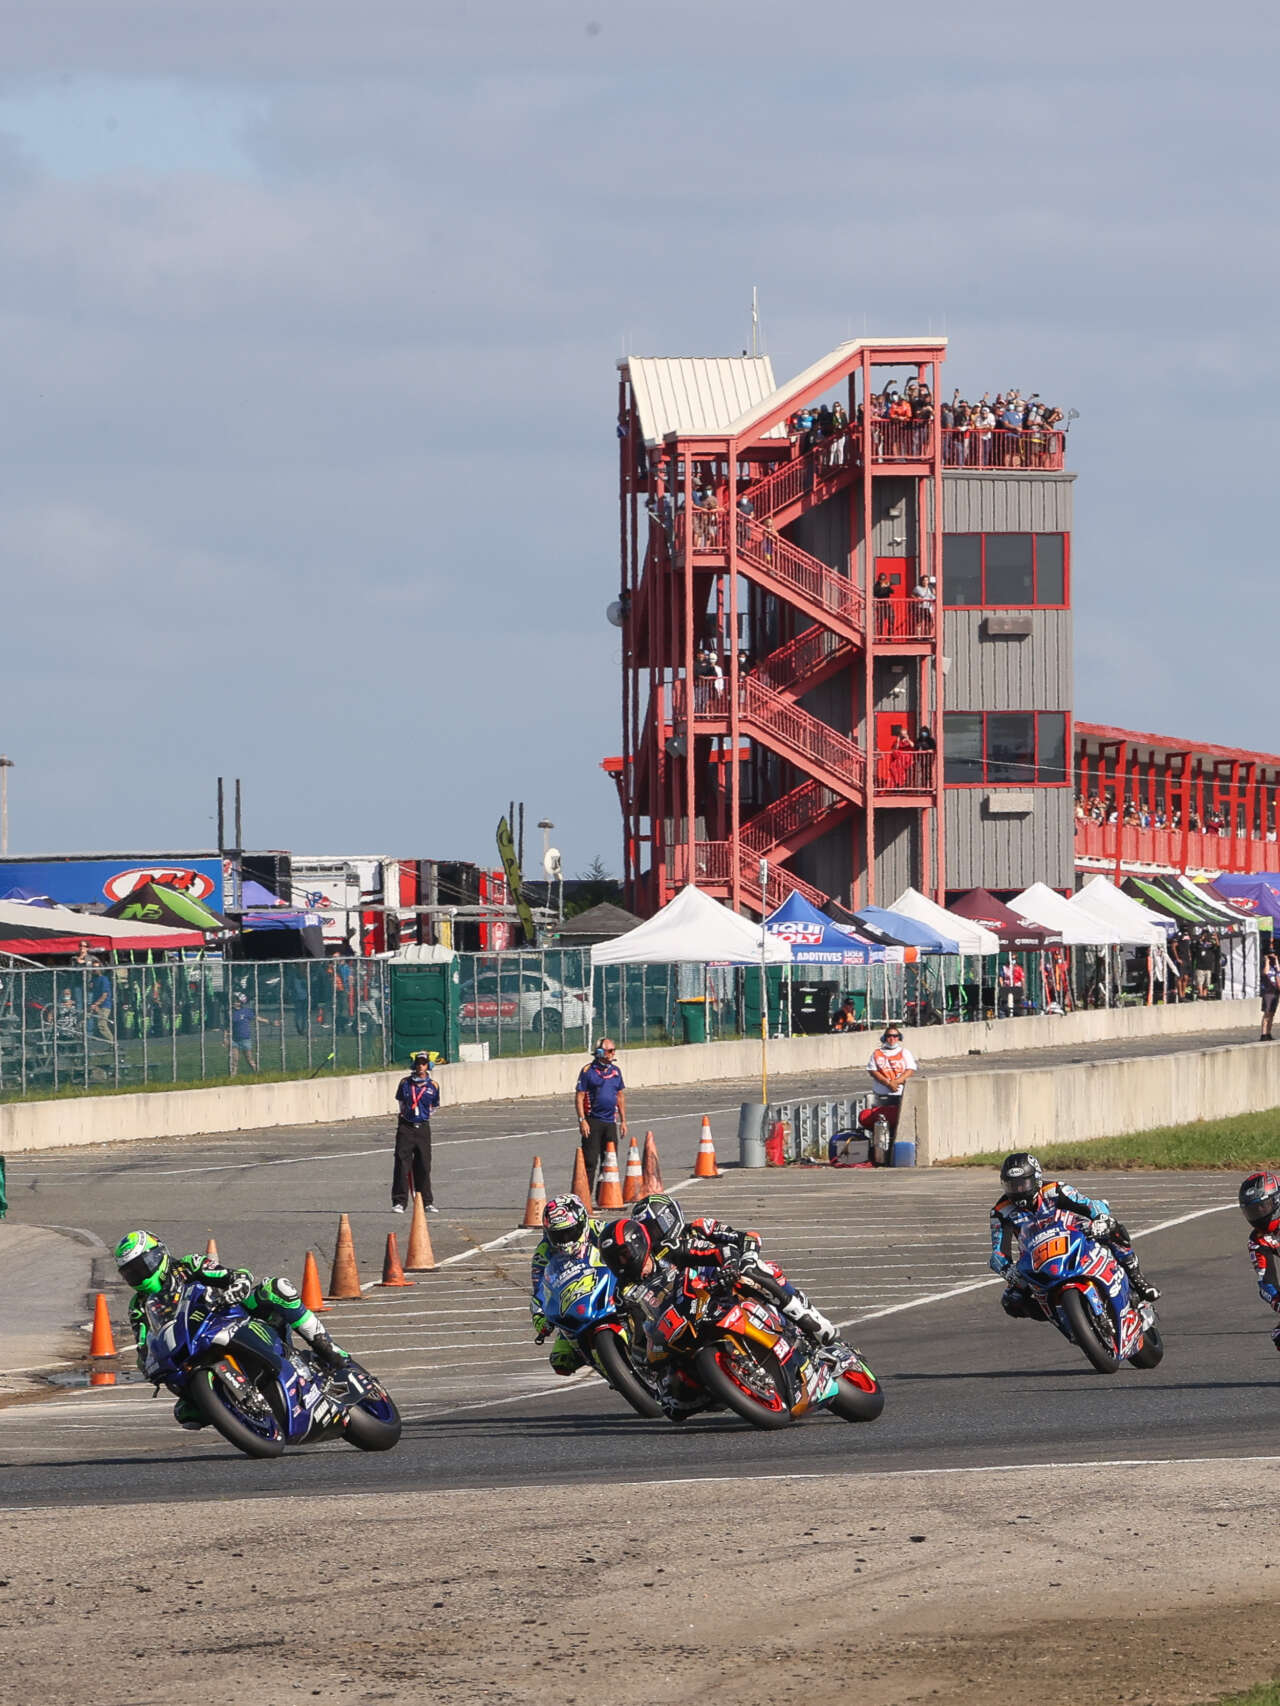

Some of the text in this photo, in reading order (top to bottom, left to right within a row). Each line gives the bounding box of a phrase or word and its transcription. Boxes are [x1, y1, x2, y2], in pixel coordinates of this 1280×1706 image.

[797, 952, 842, 962] ADDITIVES
[1033, 1237, 1066, 1269] 50
[561, 1274, 595, 1314] 24
